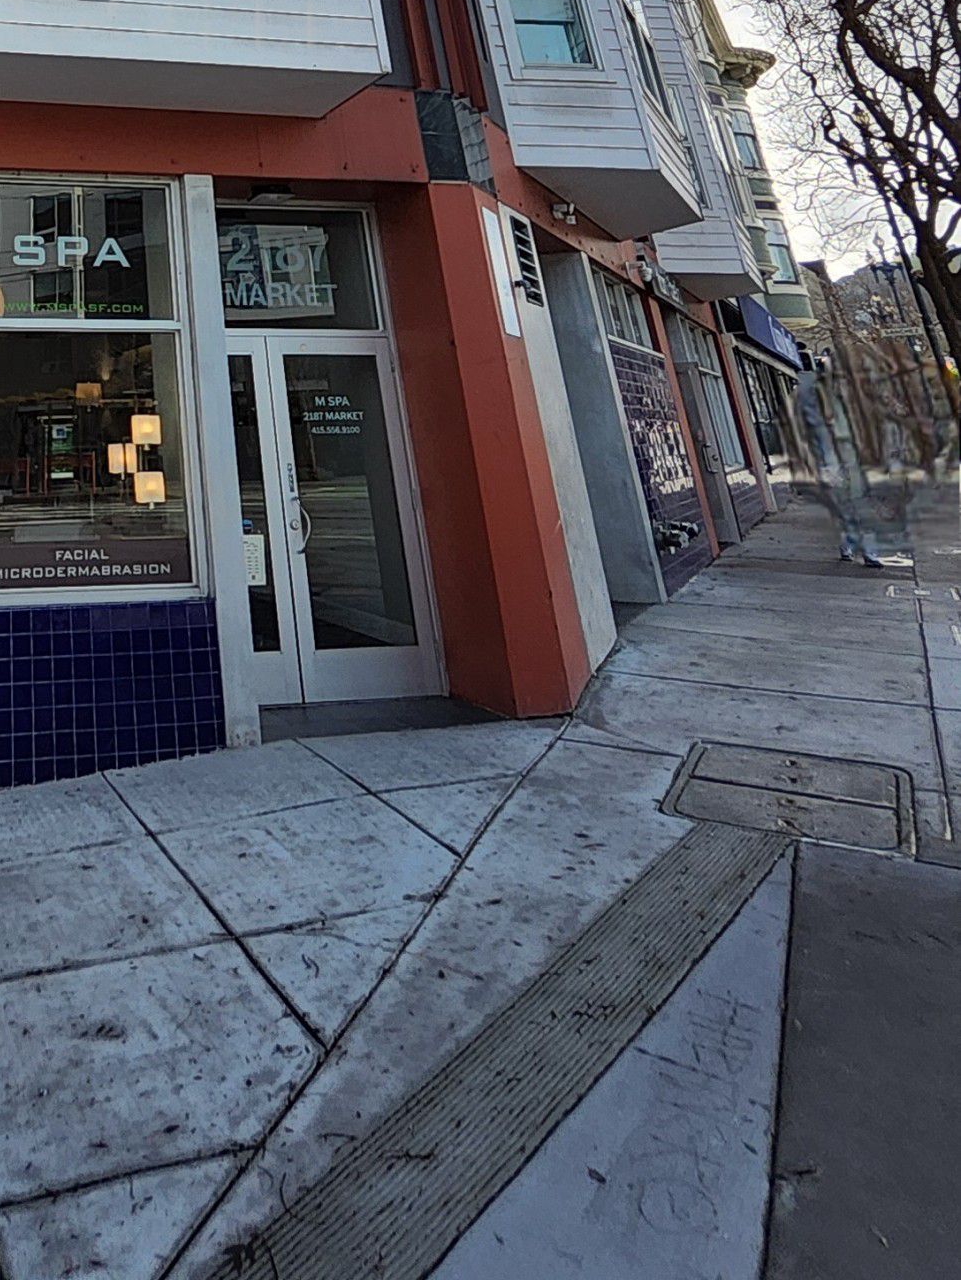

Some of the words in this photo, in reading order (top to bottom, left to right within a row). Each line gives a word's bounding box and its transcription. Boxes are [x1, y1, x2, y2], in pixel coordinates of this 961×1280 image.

[13, 235, 131, 268] SPA
[225, 282, 338, 306] MARKET
[314, 396, 326, 407] M
[328, 396, 351, 407] SPA
[303, 411, 324, 421] 2187
[325, 411, 364, 420] MARKET
[55, 549, 110, 561] FACIAL
